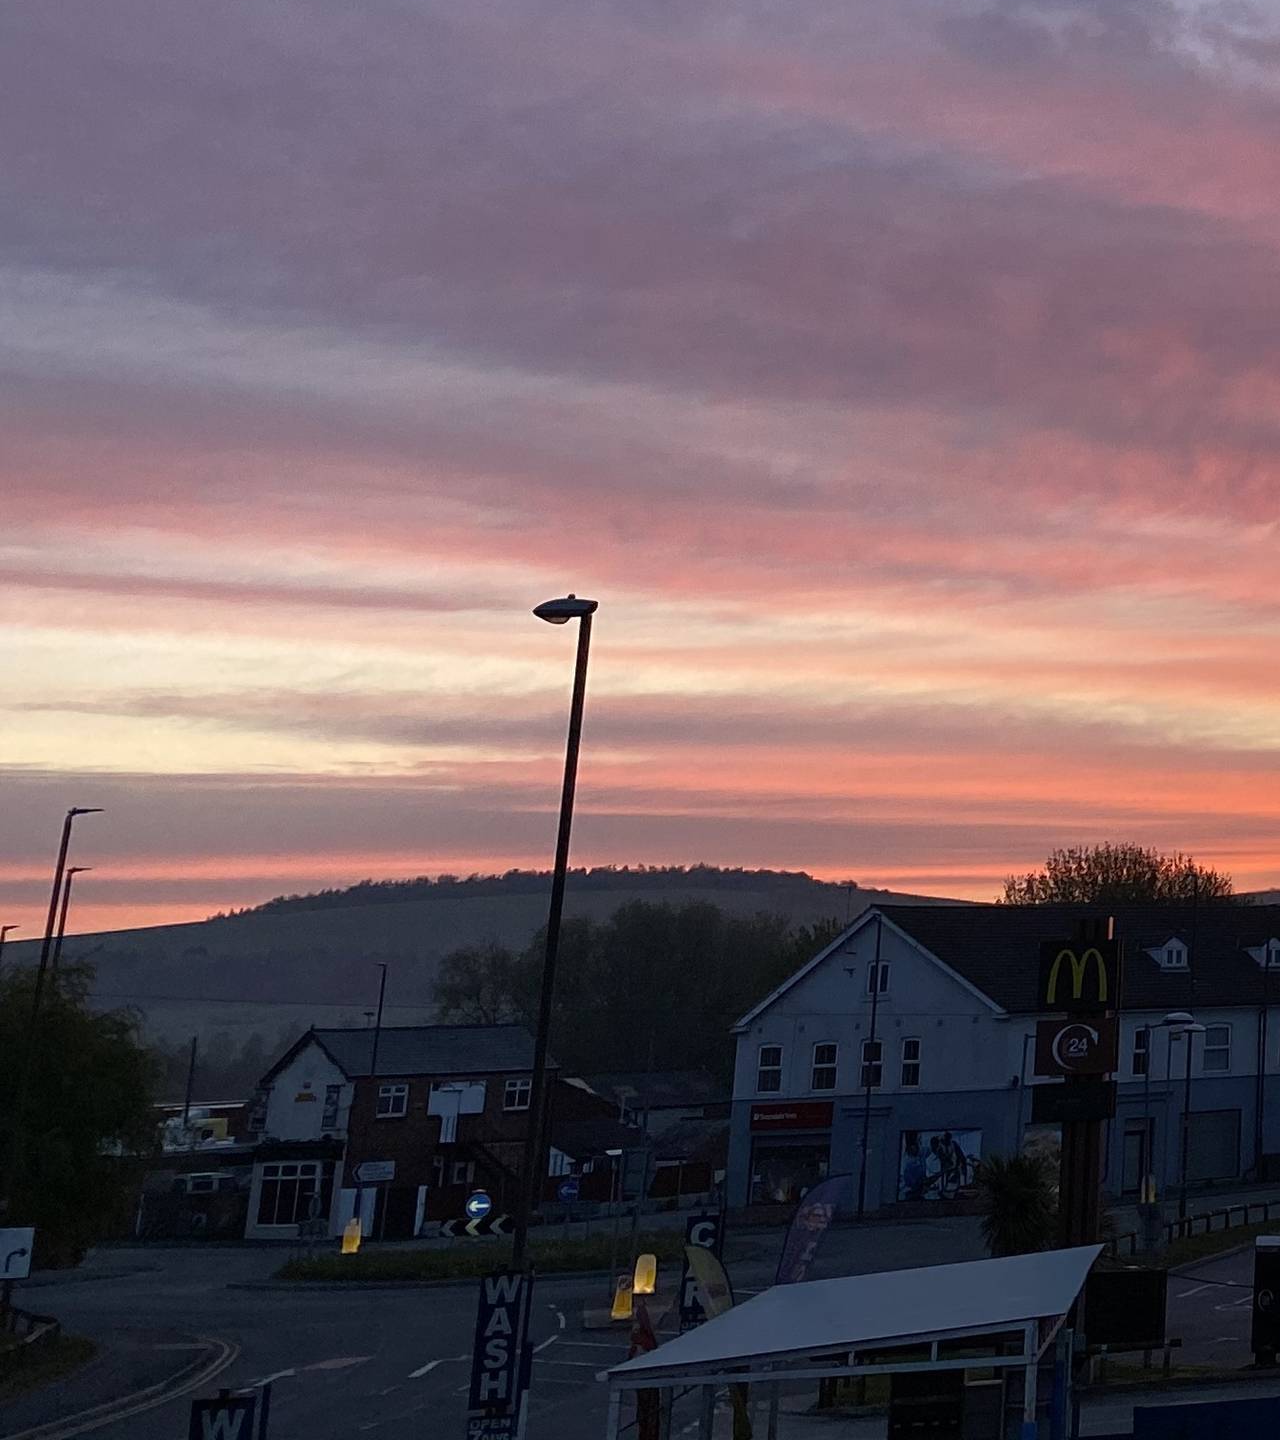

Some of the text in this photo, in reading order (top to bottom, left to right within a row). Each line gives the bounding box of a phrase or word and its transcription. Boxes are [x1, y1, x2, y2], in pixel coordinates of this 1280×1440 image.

[1069, 1037, 1088, 1052] 24
[480, 1273, 522, 1401] WASH
[469, 1417, 511, 1430] OPEN
